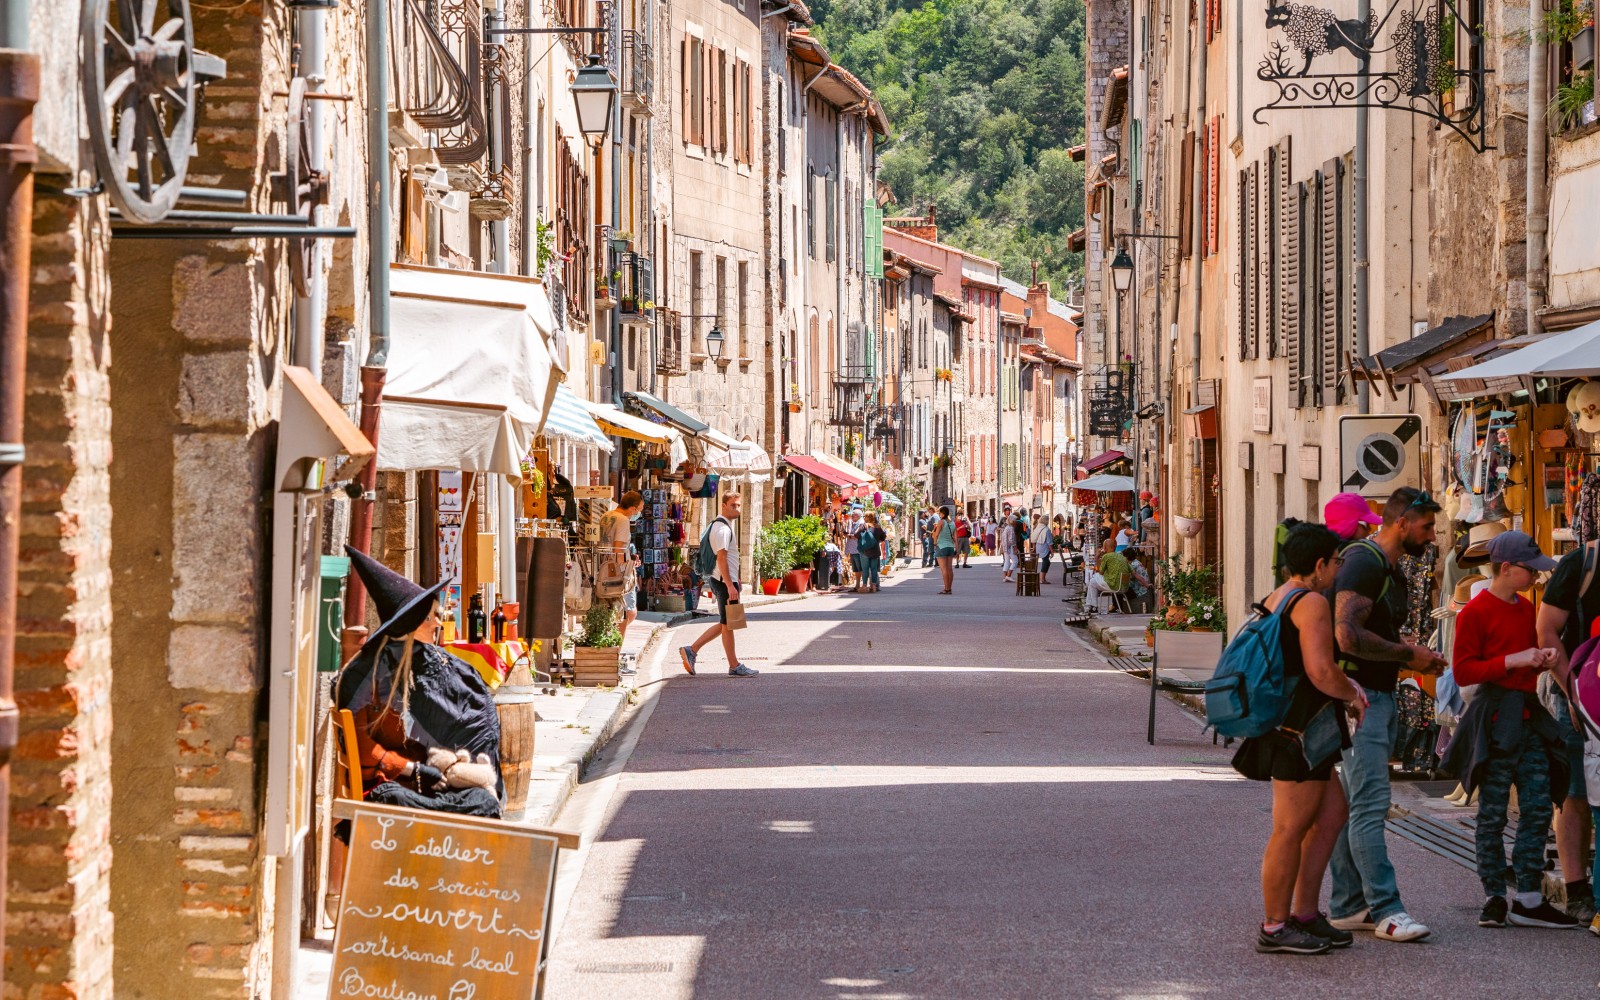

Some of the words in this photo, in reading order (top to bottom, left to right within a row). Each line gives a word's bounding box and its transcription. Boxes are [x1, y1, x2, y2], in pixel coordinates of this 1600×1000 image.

[384, 868, 419, 890] des
[428, 878, 521, 903] sorcières
[383, 903, 506, 934] ouvert
[342, 933, 455, 966] artisanat
[463, 947, 519, 975] local
